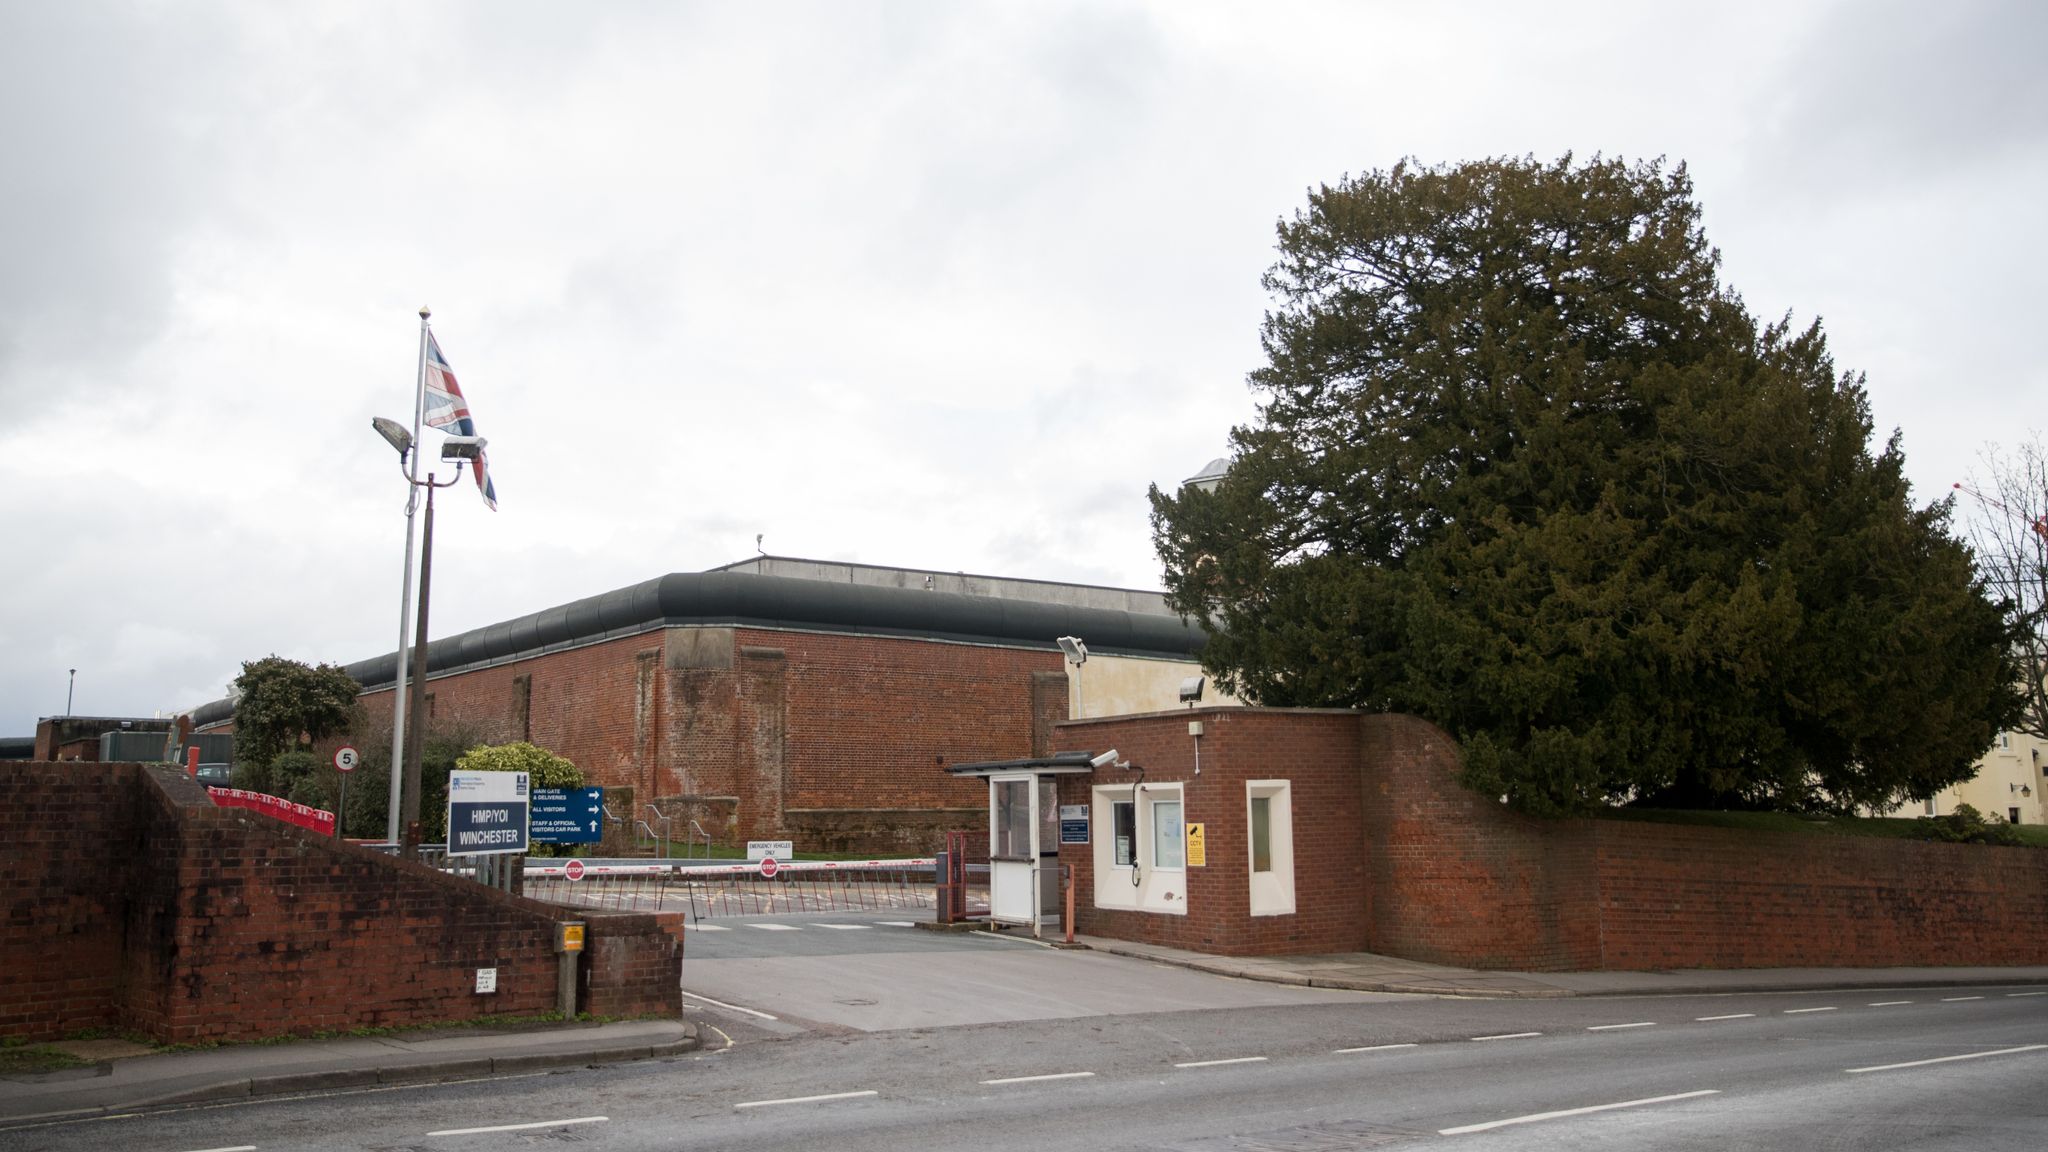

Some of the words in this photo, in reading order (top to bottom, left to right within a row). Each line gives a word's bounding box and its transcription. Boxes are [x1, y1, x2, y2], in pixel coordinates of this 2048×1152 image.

[343, 753, 351, 764] 5
[472, 809, 508, 823] HMP/YOI
[460, 830, 518, 845] WINCHESTER
